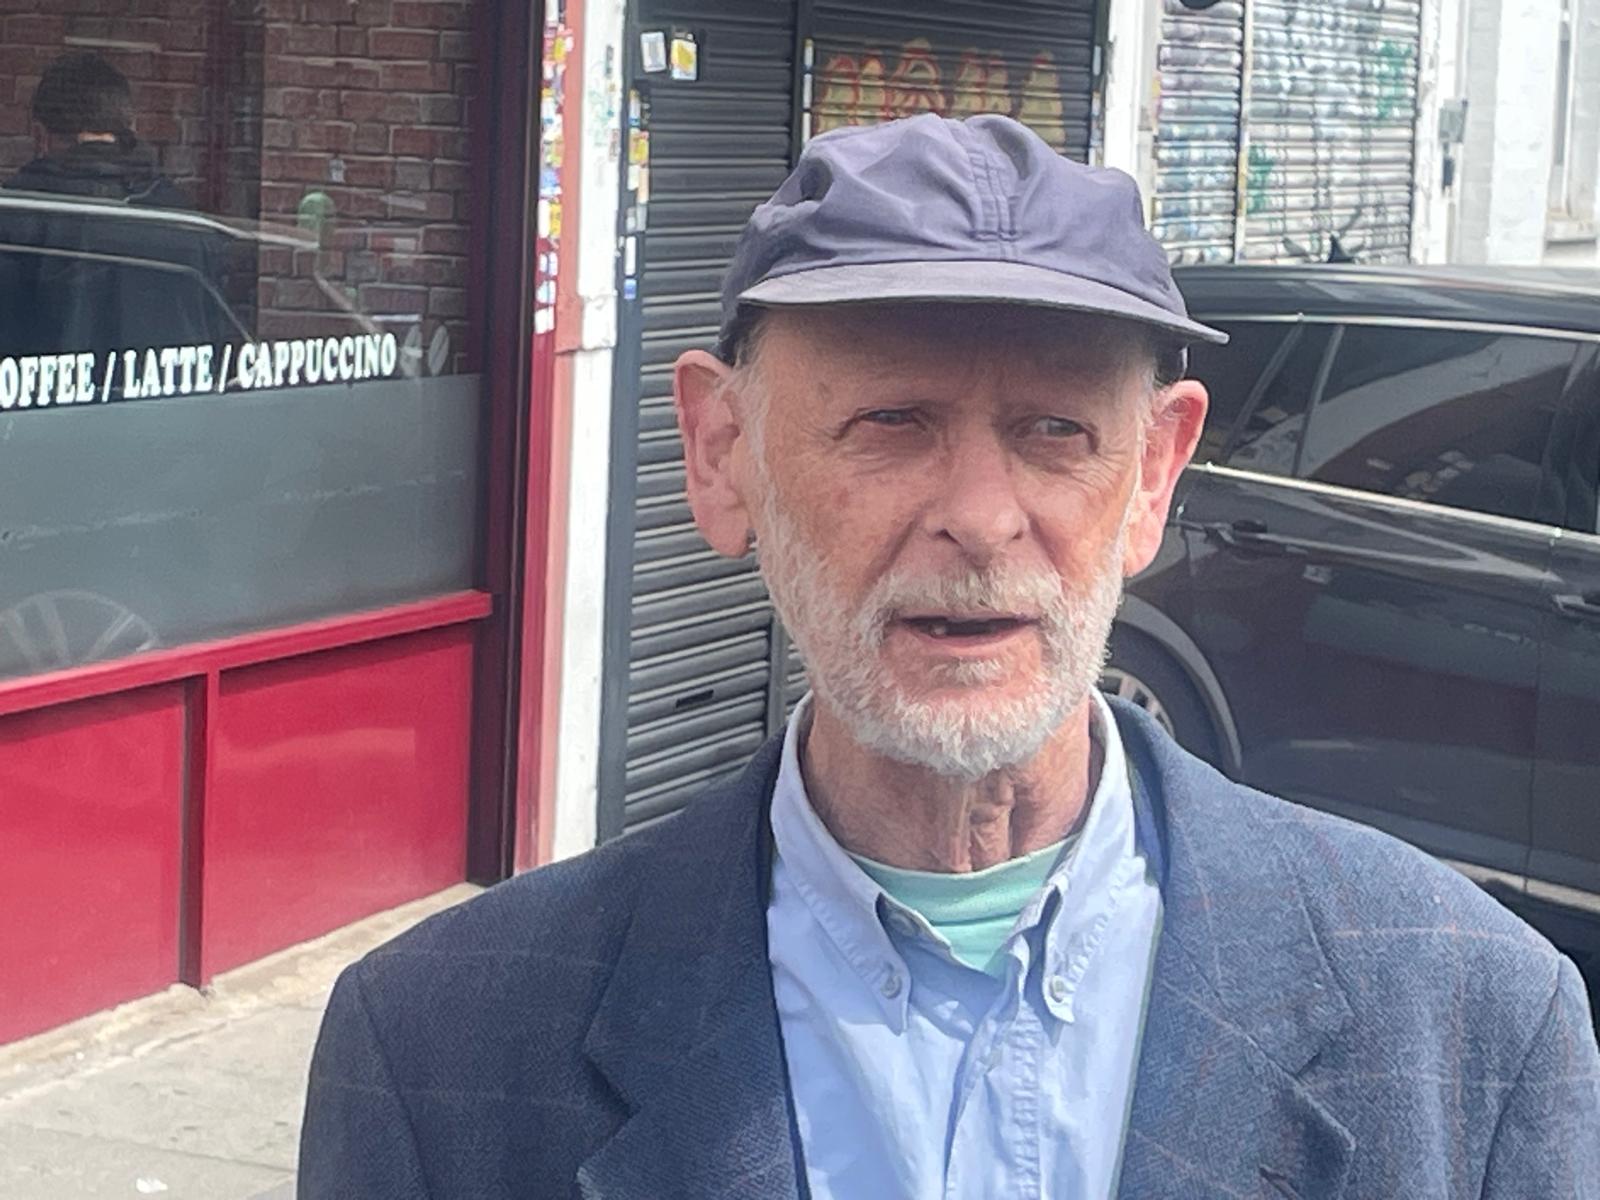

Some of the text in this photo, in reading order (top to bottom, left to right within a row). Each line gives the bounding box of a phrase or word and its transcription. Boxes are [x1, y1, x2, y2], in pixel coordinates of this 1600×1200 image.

[0, 352, 95, 408] OFFEE
[123, 345, 213, 398] LATTE
[237, 332, 397, 389] CAPPUCCINO
